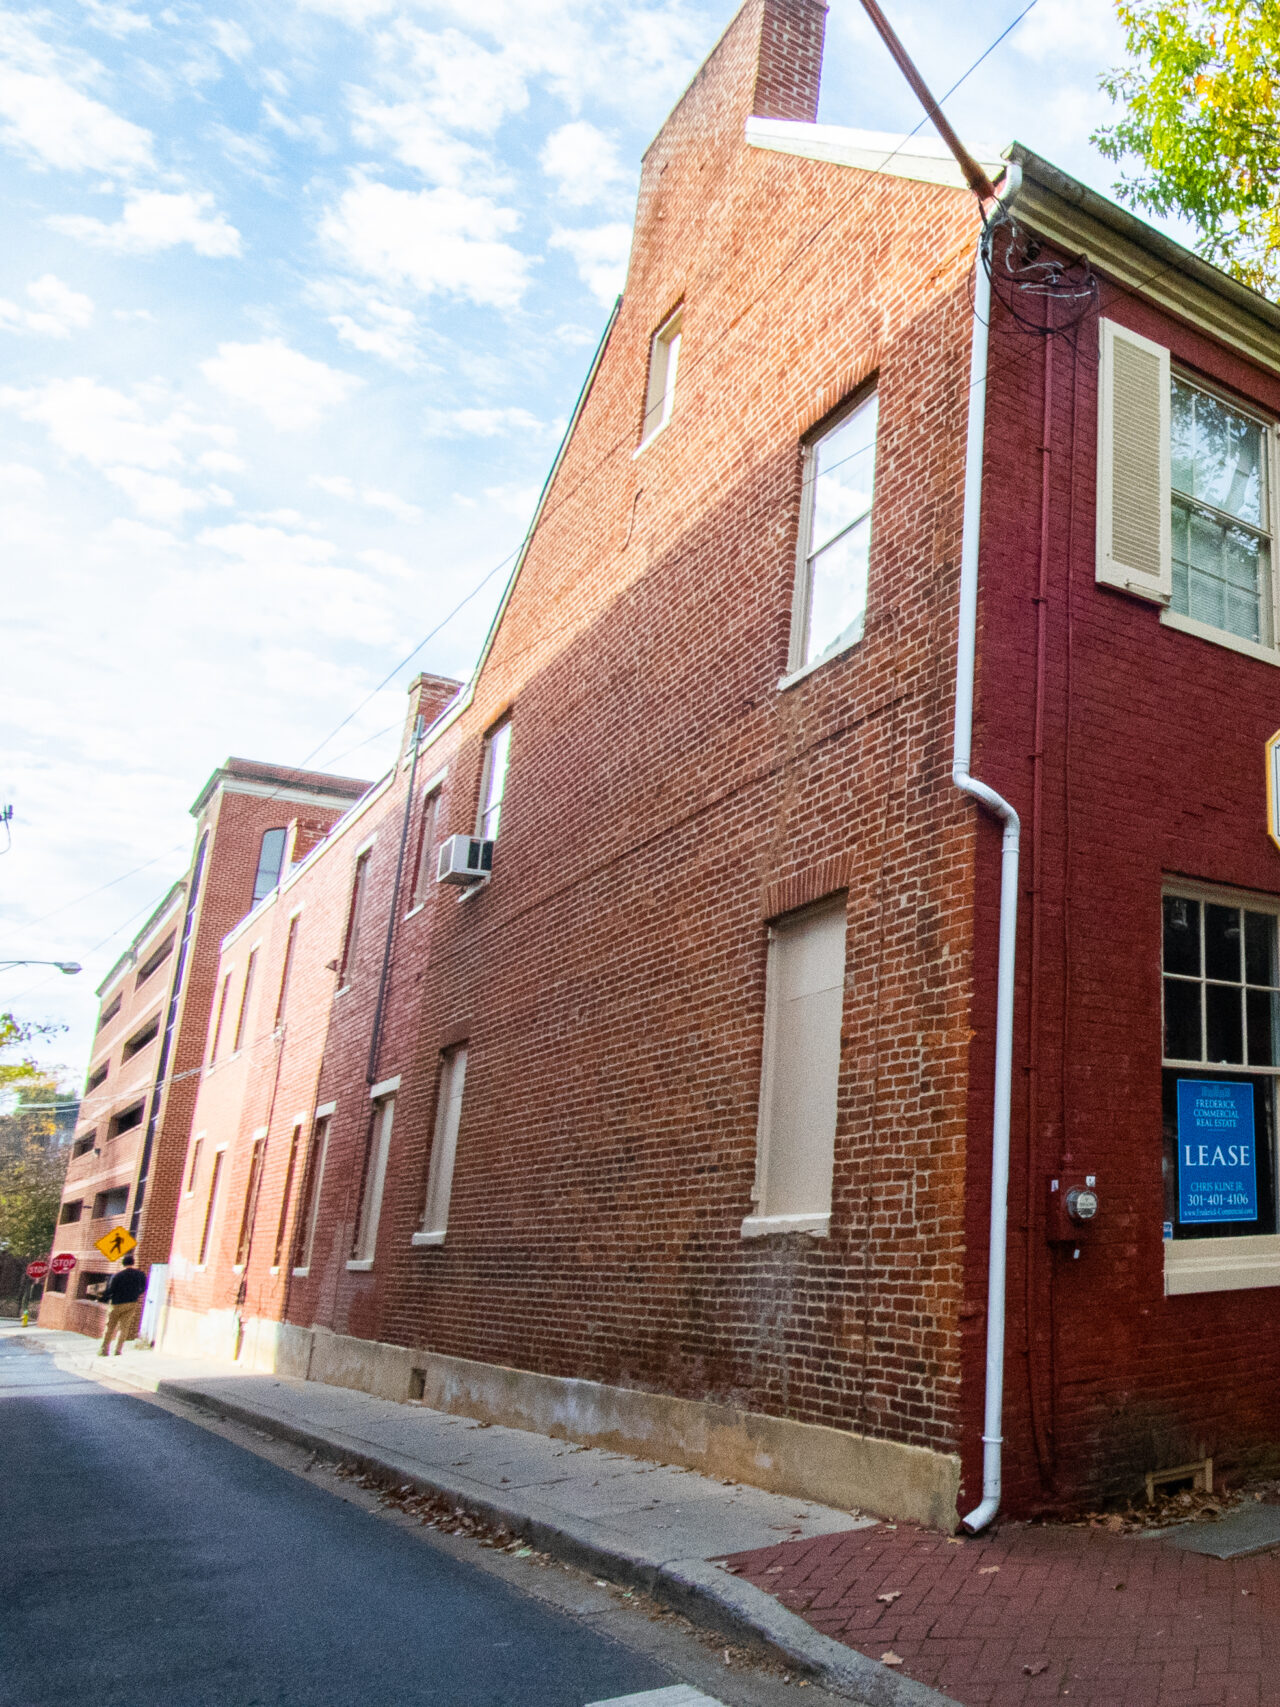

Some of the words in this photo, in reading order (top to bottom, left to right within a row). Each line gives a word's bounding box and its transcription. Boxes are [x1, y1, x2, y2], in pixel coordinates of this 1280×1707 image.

[1195, 1099, 1236, 1109] FREDERICK
[1193, 1109, 1239, 1119] COMMERCIAL
[1196, 1118, 1213, 1127] REAL
[1214, 1119, 1237, 1128] ESTATE
[1184, 1144, 1251, 1166] LEASE
[1190, 1181, 1213, 1192] CHRIS
[1214, 1181, 1234, 1191] KLINE
[1187, 1193, 1249, 1207] 301-401-4106
[52, 1259, 75, 1267] STOP
